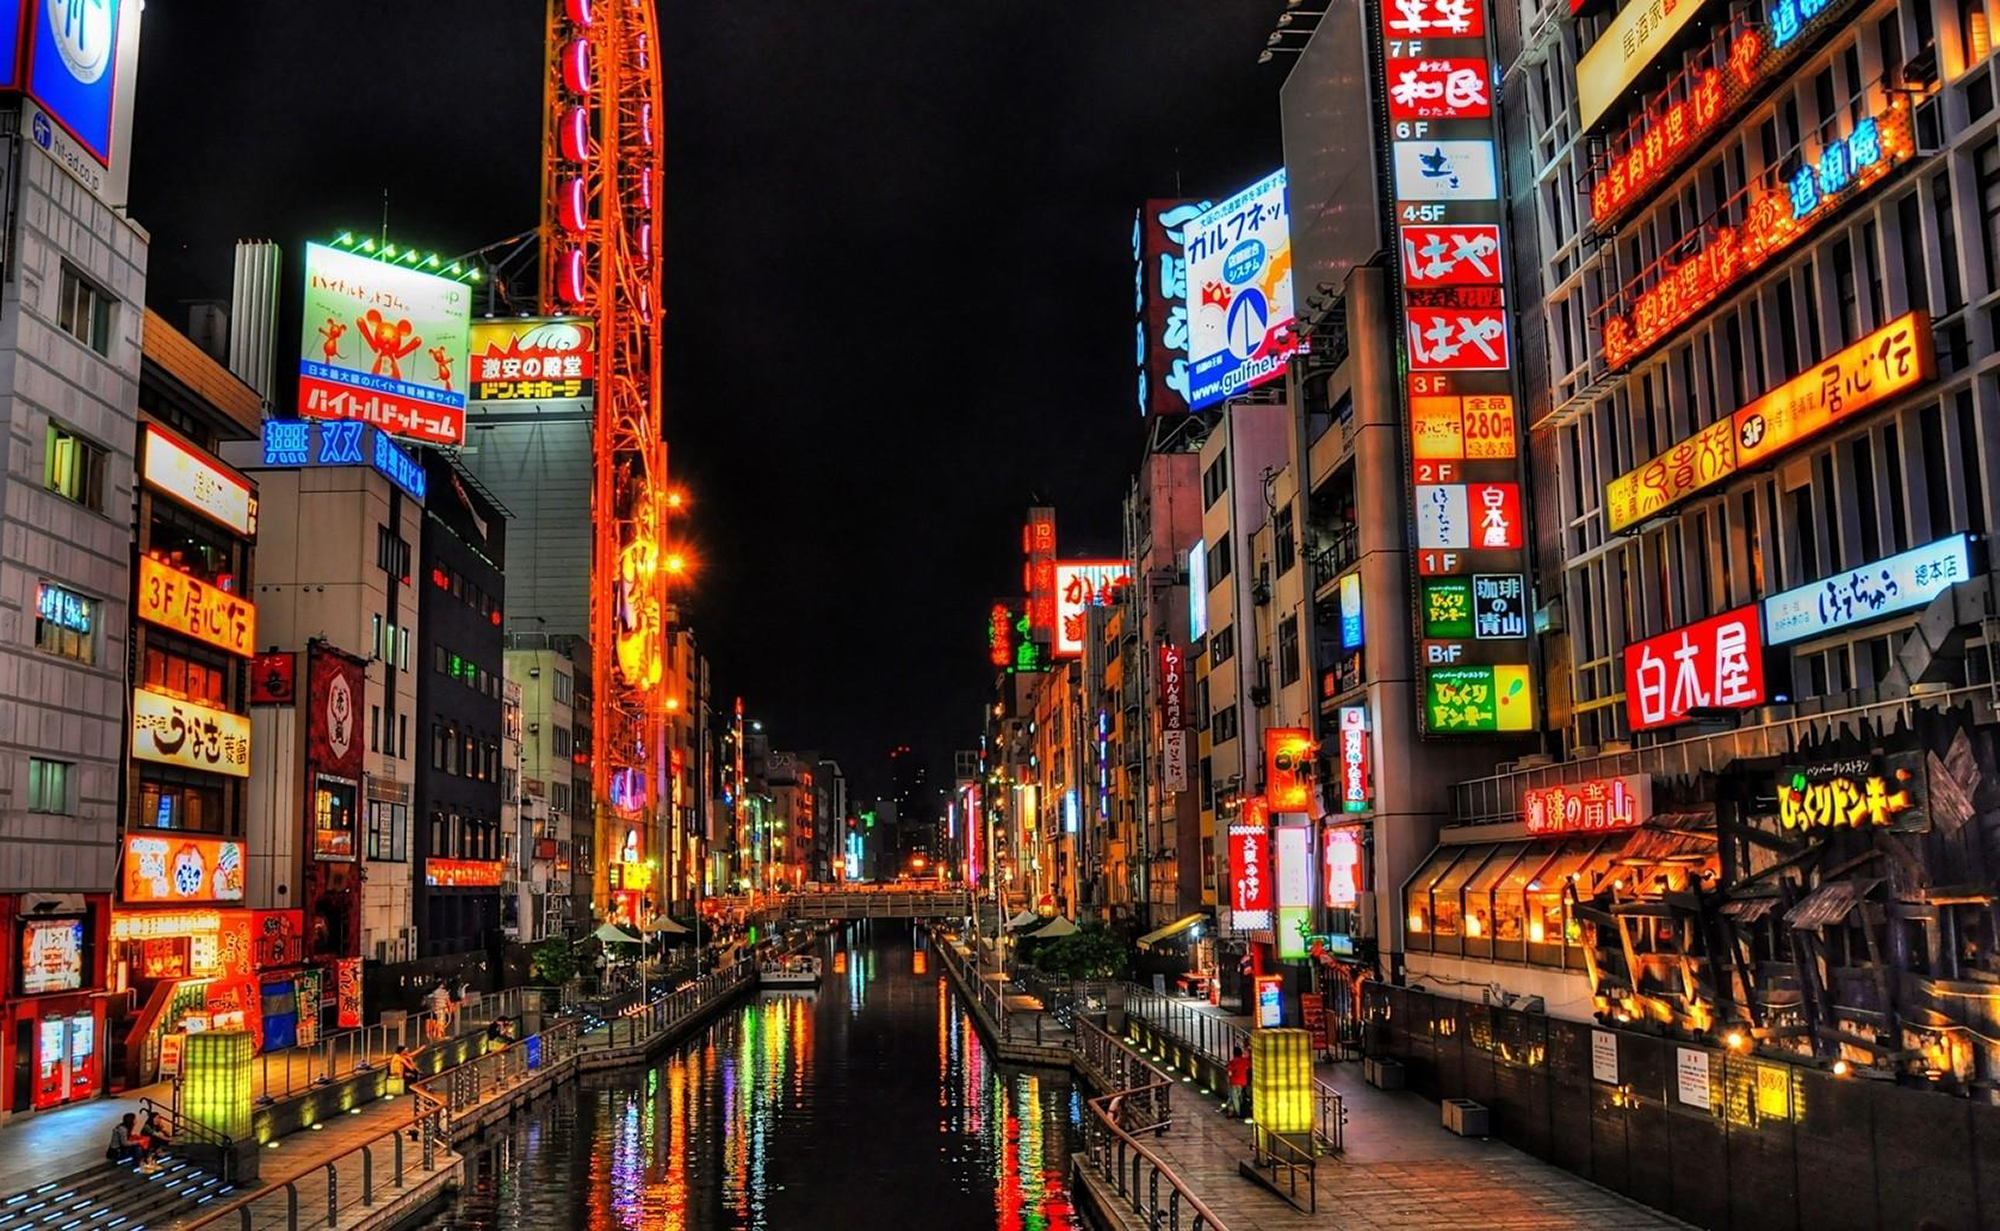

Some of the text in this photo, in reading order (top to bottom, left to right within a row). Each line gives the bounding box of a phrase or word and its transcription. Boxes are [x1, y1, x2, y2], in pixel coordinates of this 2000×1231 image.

[1390, 68, 1488, 108] 和民
[1418, 107, 1456, 116] わたみ
[1404, 233, 1497, 280] はや
[1409, 316, 1503, 364] はや
[481, 355, 583, 379] 激安の殿堂
[307, 387, 456, 438] バイトルドットコム
[1468, 397, 1507, 411] 全品
[1465, 411, 1513, 440] 280円
[1742, 416, 1763, 447] 3F
[1480, 485, 1511, 547] 白木屋
[1476, 578, 1520, 599] 珈琲
[1430, 593, 1465, 609] びっくり
[1491, 598, 1508, 613] の
[1429, 608, 1467, 622] ドンキー
[1479, 612, 1523, 635] 青山
[1427, 644, 1462, 664] B1F
[1636, 621, 1757, 724] 白木屋
[1434, 682, 1489, 706] びっくり
[1432, 705, 1493, 728] ドンキー
[1776, 776, 1909, 832] びっくりドンキー
